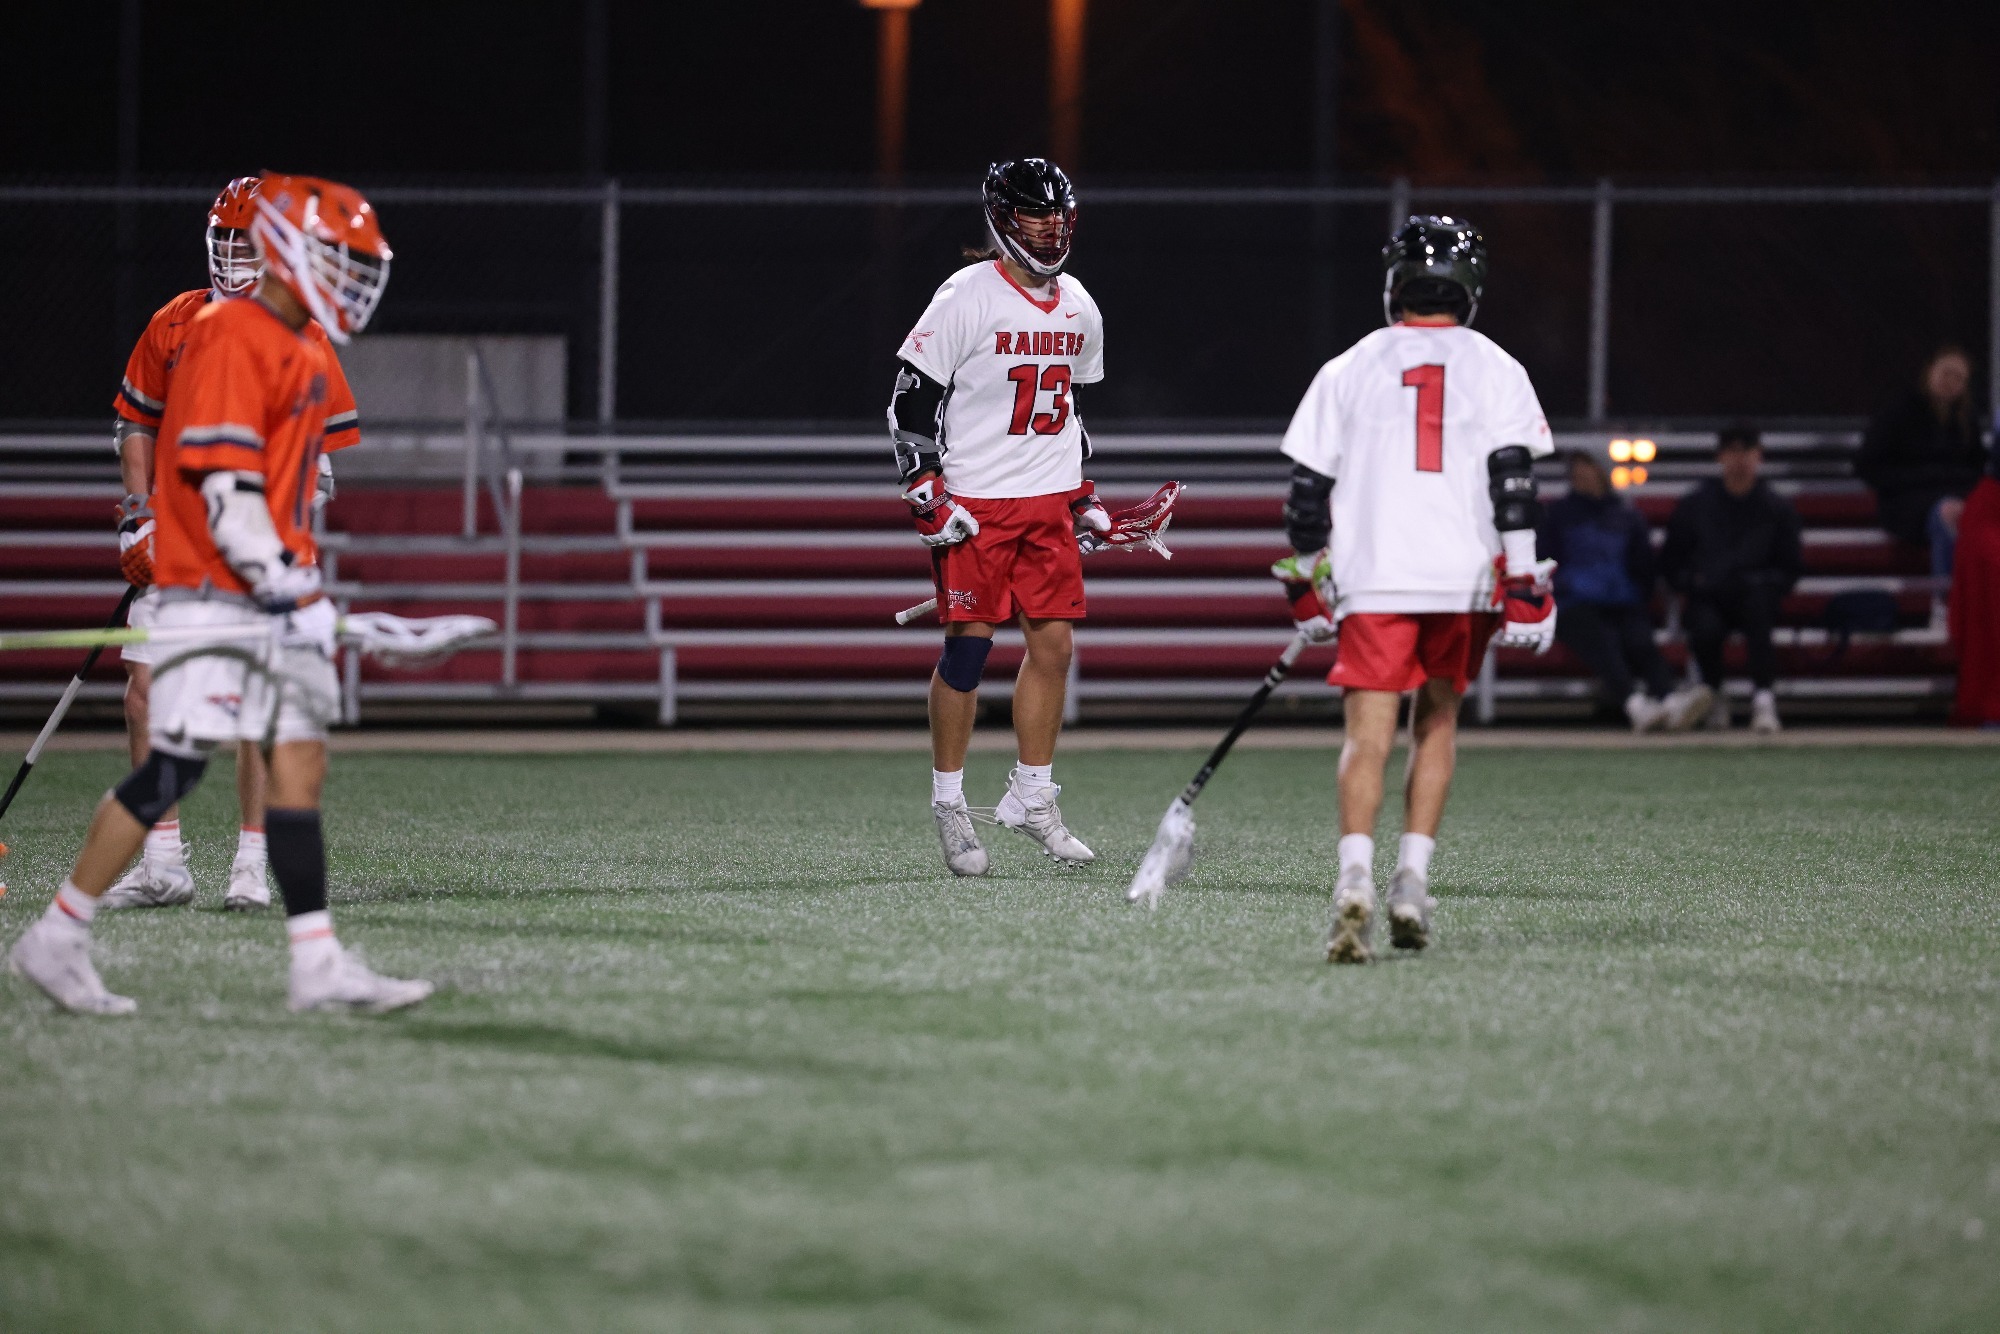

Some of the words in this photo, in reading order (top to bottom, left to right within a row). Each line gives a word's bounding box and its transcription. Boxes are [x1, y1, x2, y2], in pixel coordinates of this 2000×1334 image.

[995, 331, 1085, 356] RAIDERS
[1007, 363, 1071, 435] 13
[1402, 364, 1445, 472] 1
